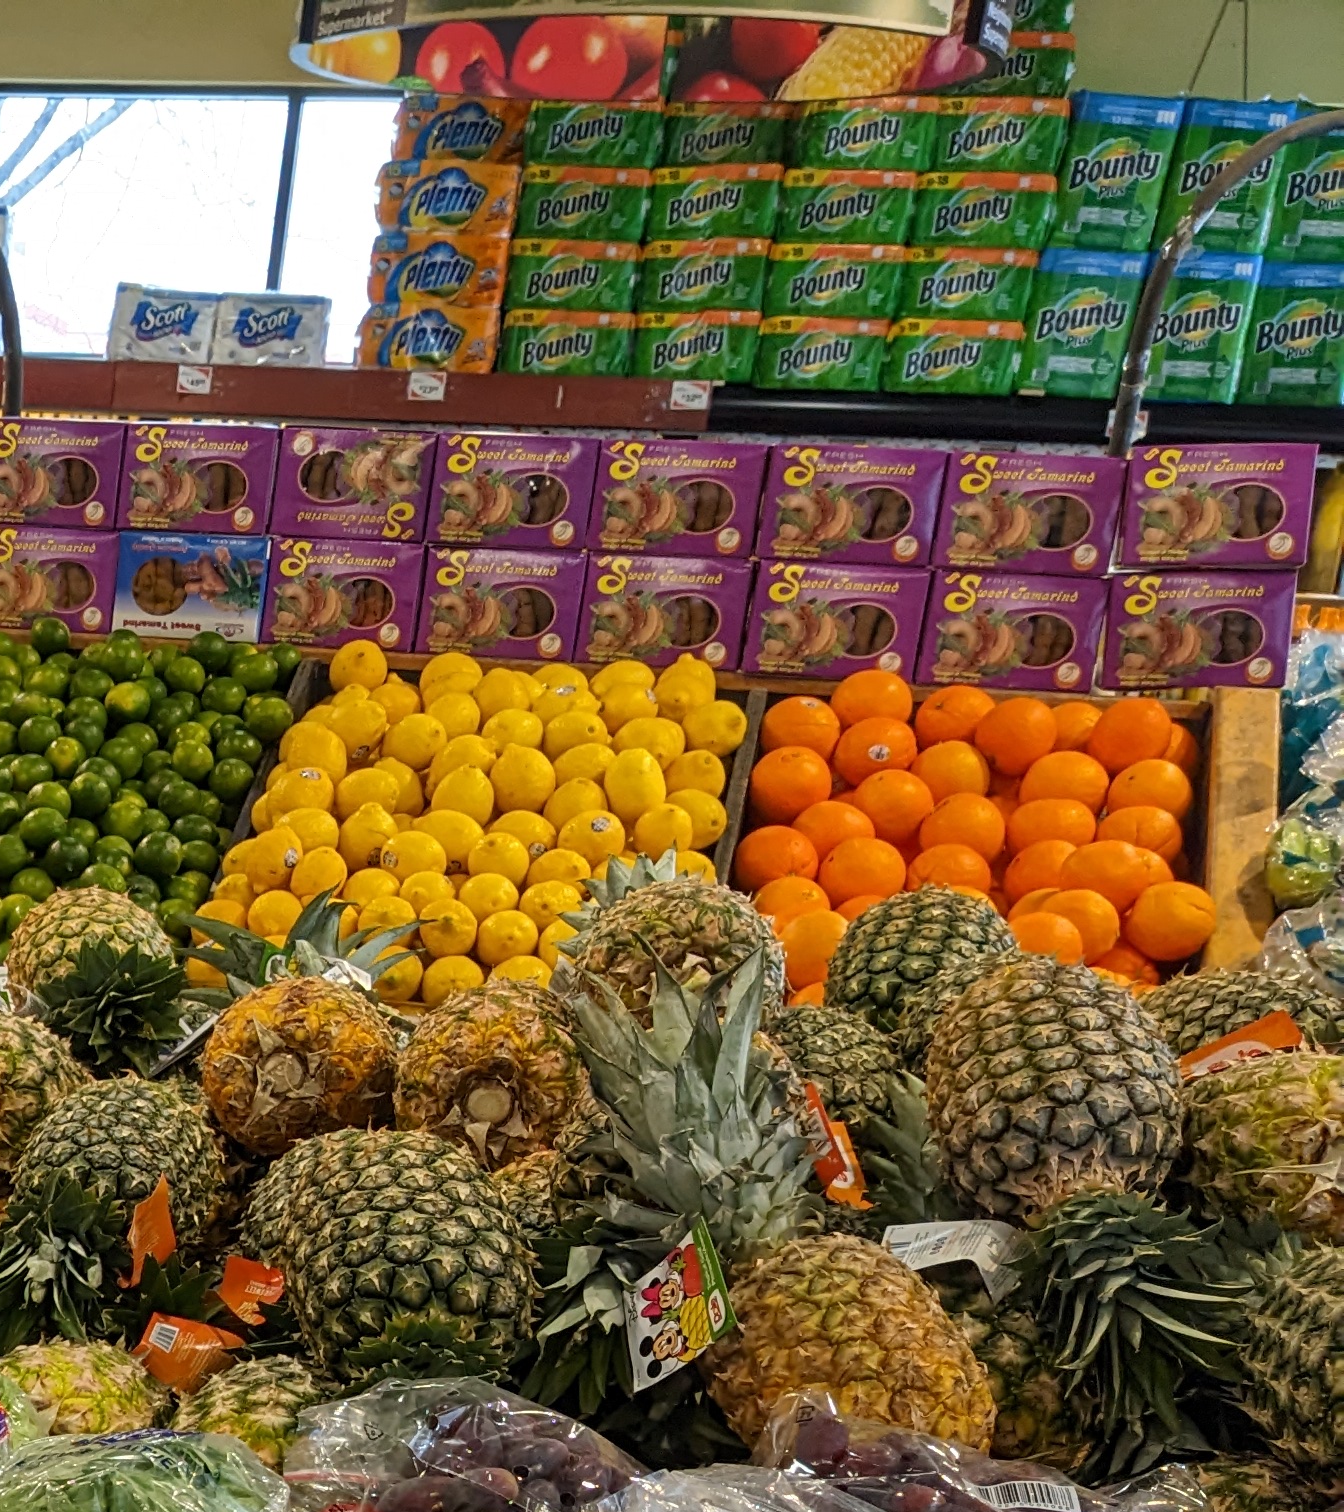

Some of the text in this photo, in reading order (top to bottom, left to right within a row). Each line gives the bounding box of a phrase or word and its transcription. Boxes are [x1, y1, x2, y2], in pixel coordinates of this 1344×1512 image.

[825, 116, 900, 154] Bounty
[1069, 151, 1160, 190] Bounty
[415, 183, 484, 216] Plenty
[537, 189, 610, 226] Bounty
[934, 195, 1012, 233] Bounty
[404, 258, 472, 291] Plenty
[527, 262, 599, 299] Bounty
[660, 260, 731, 300] Bounty
[140, 306, 187, 333] Scott
[906, 341, 981, 379] Bounty
[610, 443, 736, 480] Sweet Tamarind
[960, 455, 1095, 494] Sweet Tamarind
